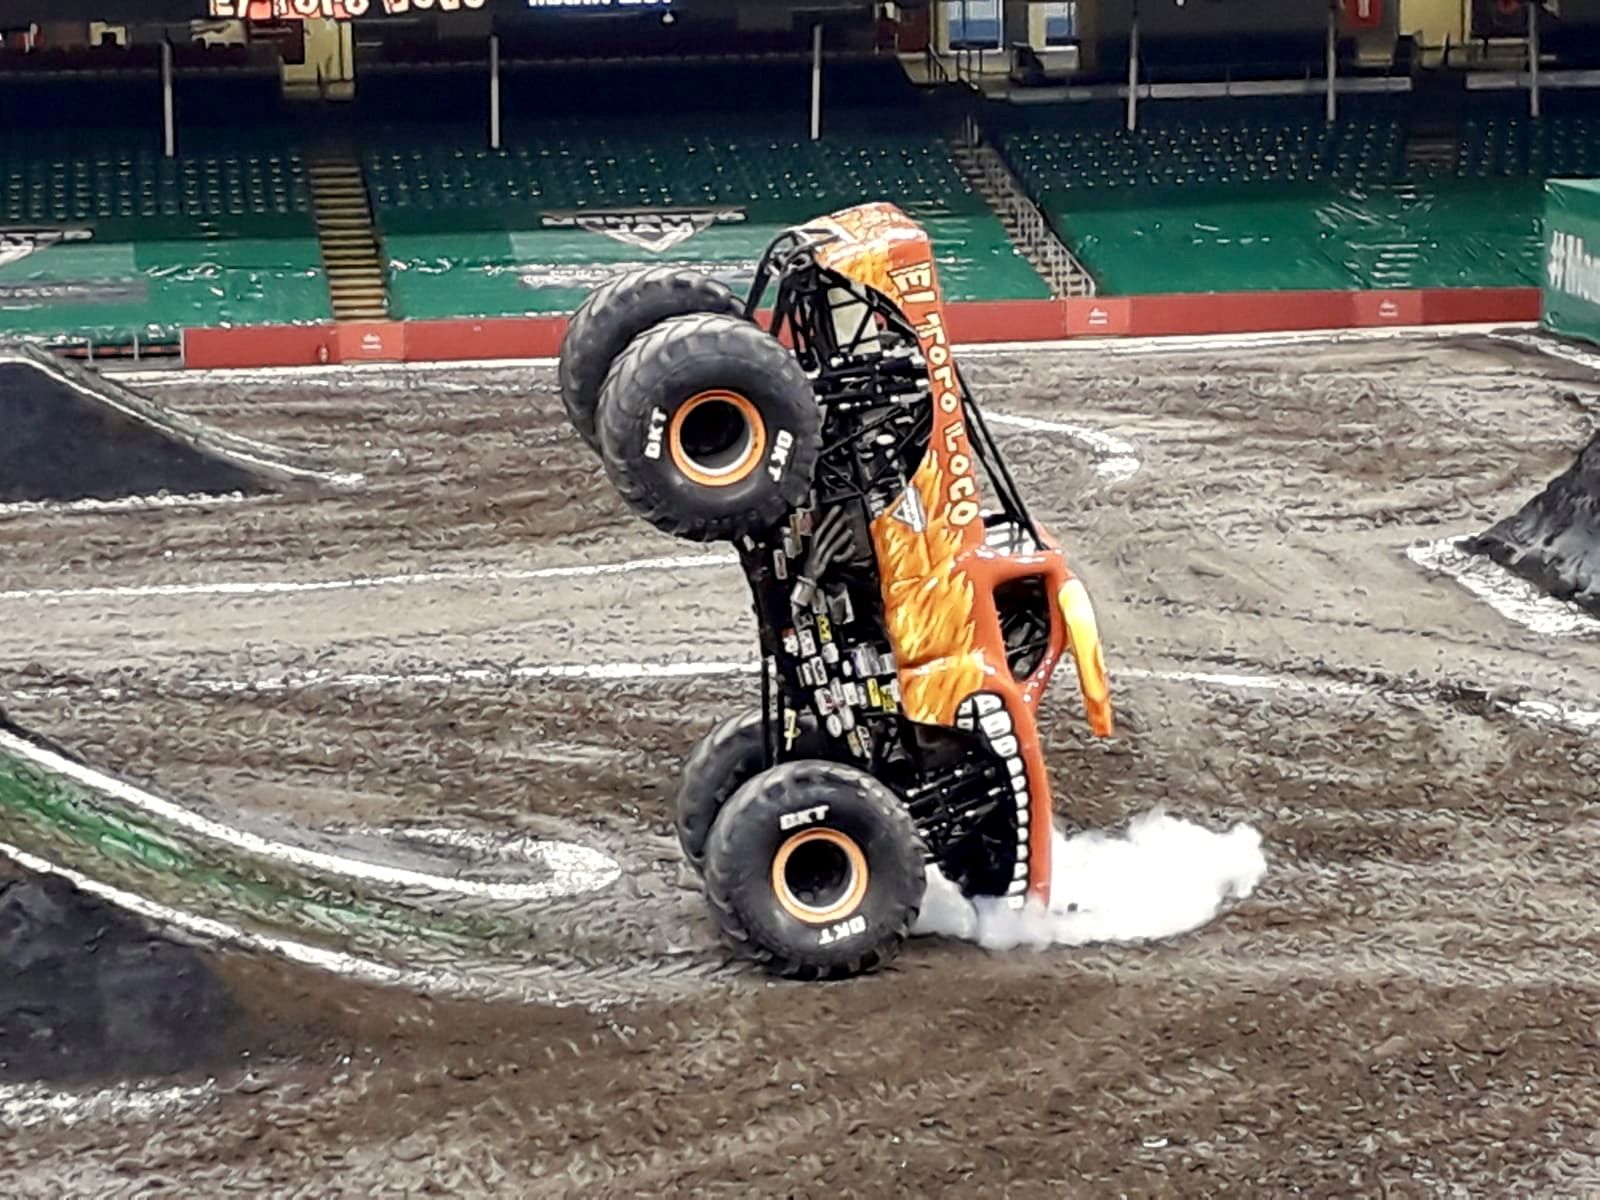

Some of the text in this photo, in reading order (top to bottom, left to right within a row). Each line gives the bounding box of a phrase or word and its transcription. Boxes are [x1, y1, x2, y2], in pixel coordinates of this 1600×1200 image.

[888, 261, 979, 526] El Toro Loco
[644, 405, 668, 460] BKT
[767, 428, 794, 482] BKT
[779, 804, 830, 832] BKT
[818, 914, 867, 945] BKT
